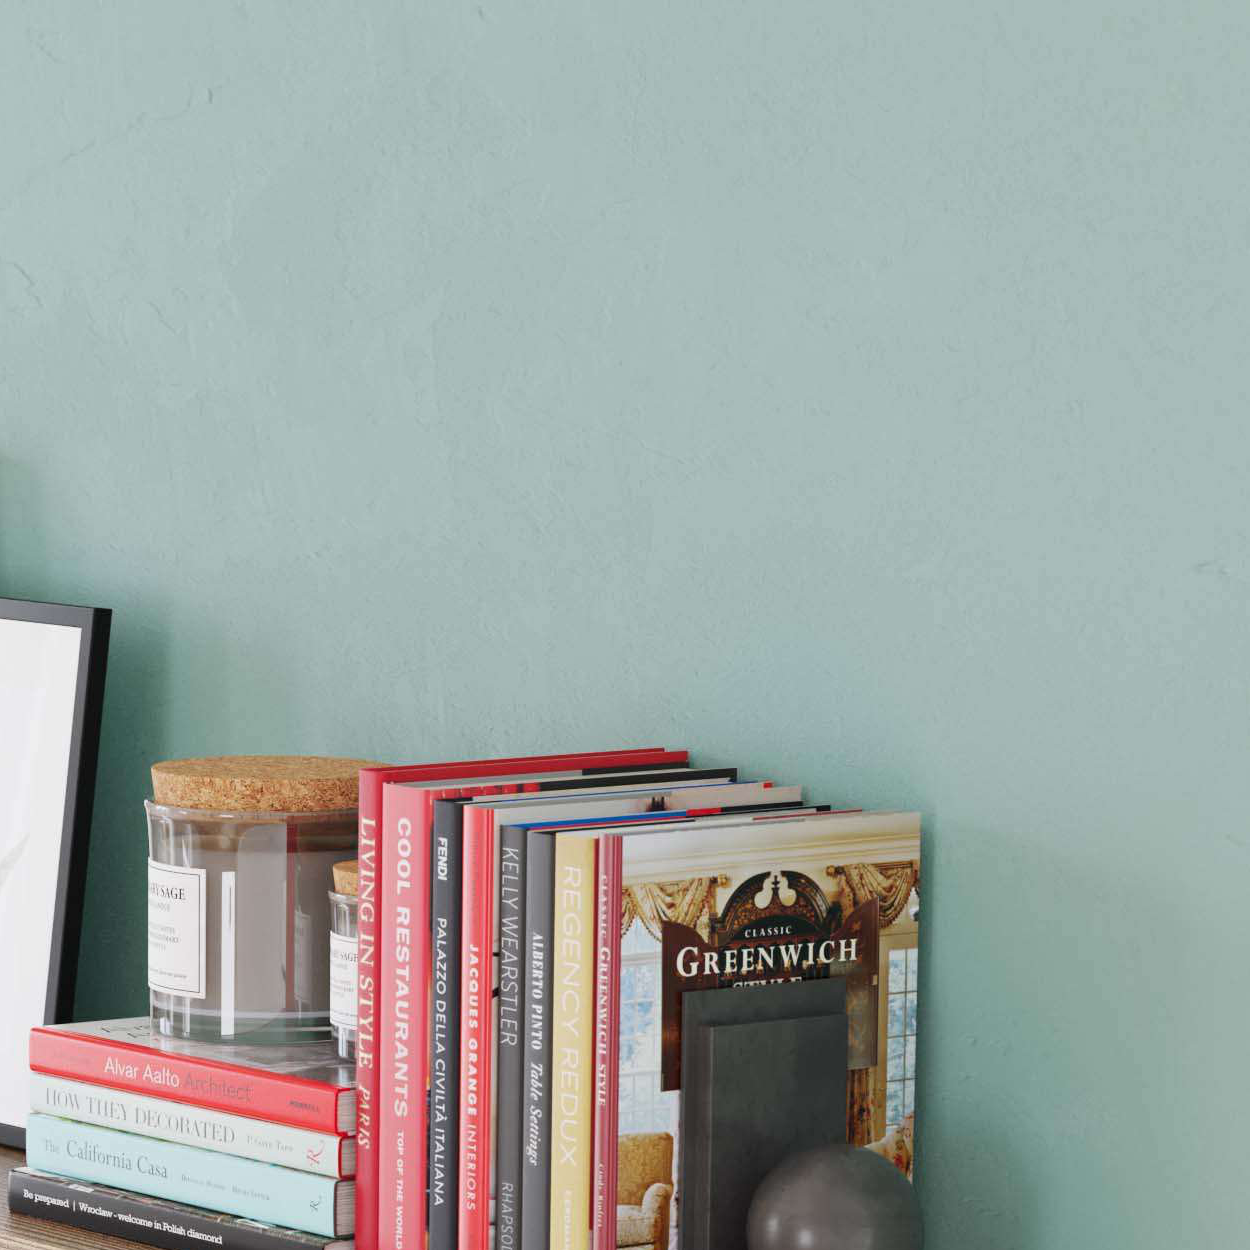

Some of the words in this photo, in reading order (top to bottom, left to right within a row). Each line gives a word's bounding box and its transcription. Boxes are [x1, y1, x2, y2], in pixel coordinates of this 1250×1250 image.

[360, 817, 376, 922] LIVING
[397, 817, 412, 896] COOL
[437, 837, 448, 881] FENDI
[501, 847, 519, 910] KELLY
[600, 874, 608, 938] CLASSIC
[744, 925, 793, 939] CLASSIC
[360, 932, 375, 968] IN
[436, 917, 448, 995] PALAZZO
[500, 916, 518, 1046] WEARSTLER
[531, 931, 544, 999] ALBERTO
[559, 865, 582, 1037] REGENCY
[675, 938, 858, 978] GREENWICH
[394, 907, 411, 1118] RESTAURANTS
[468, 943, 479, 1029] JACQUES
[598, 946, 611, 1054] GREENWICH
[358, 974, 374, 1070] STYLE
[435, 1000, 447, 1054] DELLA
[531, 1003, 543, 1050] PINTO
[104, 1056, 138, 1079] Alvar
[142, 1064, 180, 1088] Aalto
[185, 1073, 253, 1101] Architect
[434, 1059, 448, 1123] CIVILTÀ
[467, 1038, 478, 1115] GRANGE
[530, 1061, 543, 1101] Table
[558, 1047, 579, 1167] REDUX
[597, 1063, 607, 1106] STYLE
[46, 1087, 80, 1111] HOW
[86, 1096, 127, 1122] THEY
[135, 1106, 236, 1145] DECORATED
[357, 1085, 371, 1149] PARIS
[397, 1130, 405, 1153] TOP
[526, 1104, 542, 1166] Settings
[45, 1139, 60, 1153] The
[66, 1139, 132, 1170] California
[137, 1155, 167, 1178] Casa
[396, 1159, 405, 1175] OF
[396, 1179, 405, 1201] THE
[434, 1128, 445, 1206] ITALIANA
[466, 1124, 477, 1210] INTERIORS
[23, 1189, 33, 1200] Be
[34, 1194, 69, 1210] prepared
[117, 1213, 153, 1229] welcome
[153, 1219, 162, 1230] in
[162, 1221, 186, 1236] Polish
[186, 1228, 223, 1245] diamond
[395, 1206, 405, 1250] WORLD
